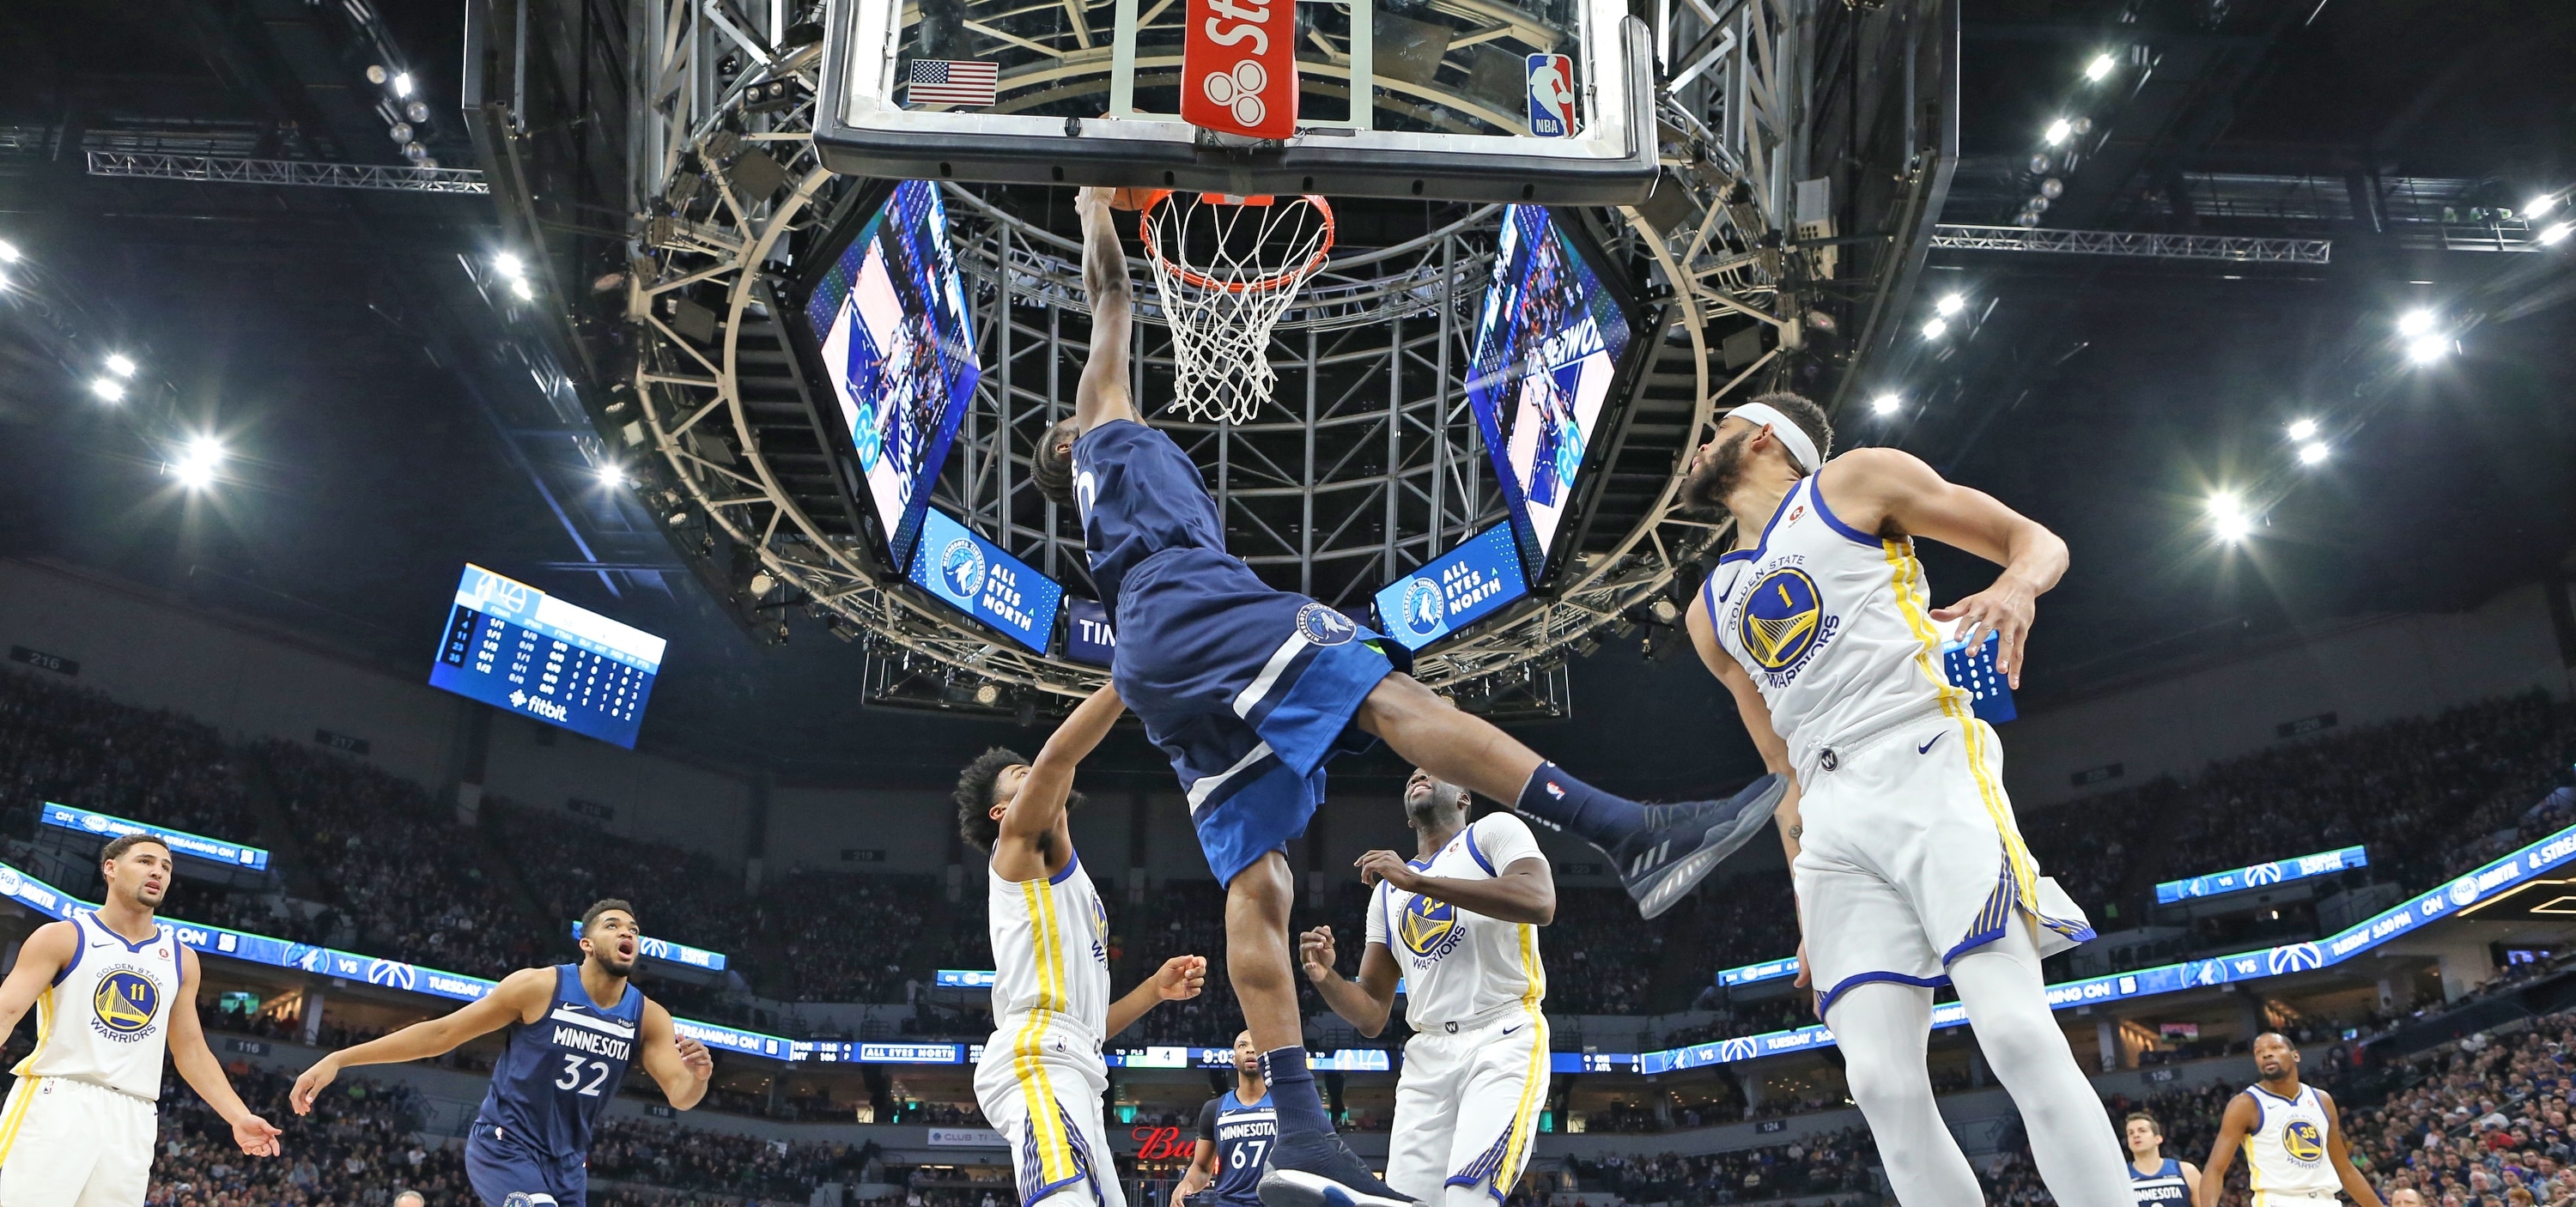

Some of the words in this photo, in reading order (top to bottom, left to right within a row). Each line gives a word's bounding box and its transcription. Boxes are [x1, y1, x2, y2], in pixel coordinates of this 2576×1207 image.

[1205, 0, 1272, 56] St
[1535, 118, 1558, 134] NBA
[990, 563, 1016, 587] ALL
[1443, 560, 1468, 583] ALL
[987, 578, 1022, 608] EYES
[1445, 570, 1481, 600] EYES
[1449, 577, 1501, 616] NORTH
[1730, 568, 1765, 631] GOLDEN
[1770, 555, 1805, 570] STATE
[1777, 583, 1794, 609] 1
[982, 593, 1032, 632] NORTH
[30, 652, 60, 670] 216
[1821, 752, 1836, 767] W
[163, 834, 217, 855] STREAMING
[217, 847, 235, 858] ON
[2218, 876, 2233, 887] VS
[2234, 960, 2257, 974] VS
[2330, 928, 2372, 956] TUESDAY
[2372, 918, 2395, 938] 5:30
[2394, 910, 2413, 928] PM
[2421, 895, 2444, 916] ON
[2528, 852, 2543, 869] &
[176, 927, 208, 946] ON
[1413, 925, 1466, 970] WARRIORS
[96, 963, 134, 979] GOLDEN
[137, 967, 164, 989] STATE
[338, 959, 358, 974] VS
[428, 975, 483, 998] TUESDAY
[130, 983, 145, 1002] 11
[2084, 982, 2111, 998] ON
[90, 1016, 157, 1044] WARRIORS
[673, 1022, 738, 1047] STREAMING
[738, 1034, 759, 1051] ON
[238, 1040, 259, 1054] 116
[553, 1025, 631, 1061] MINNESOTA
[794, 1042, 813, 1052] TOR
[866, 1047, 885, 1058] ALL
[889, 1047, 914, 1058] EYES
[918, 1047, 956, 1058] NORTH
[1699, 1049, 1714, 1061] VS
[1767, 1033, 1811, 1050] TUESDAY
[793, 1052, 808, 1061] NY
[1117, 1057, 1123, 1065] 7
[1163, 1051, 1171, 1062] 4
[1594, 1055, 1610, 1064] CHI
[555, 1053, 610, 1097] 32
[944, 1133, 972, 1142] CLUB
[1219, 1122, 1276, 1141] MINNESOTA
[1764, 1122, 1779, 1131] 124
[2300, 1126, 2318, 1140] 35
[1230, 1140, 1267, 1169] 67
[2135, 1186, 2183, 1203] INNESOTA
